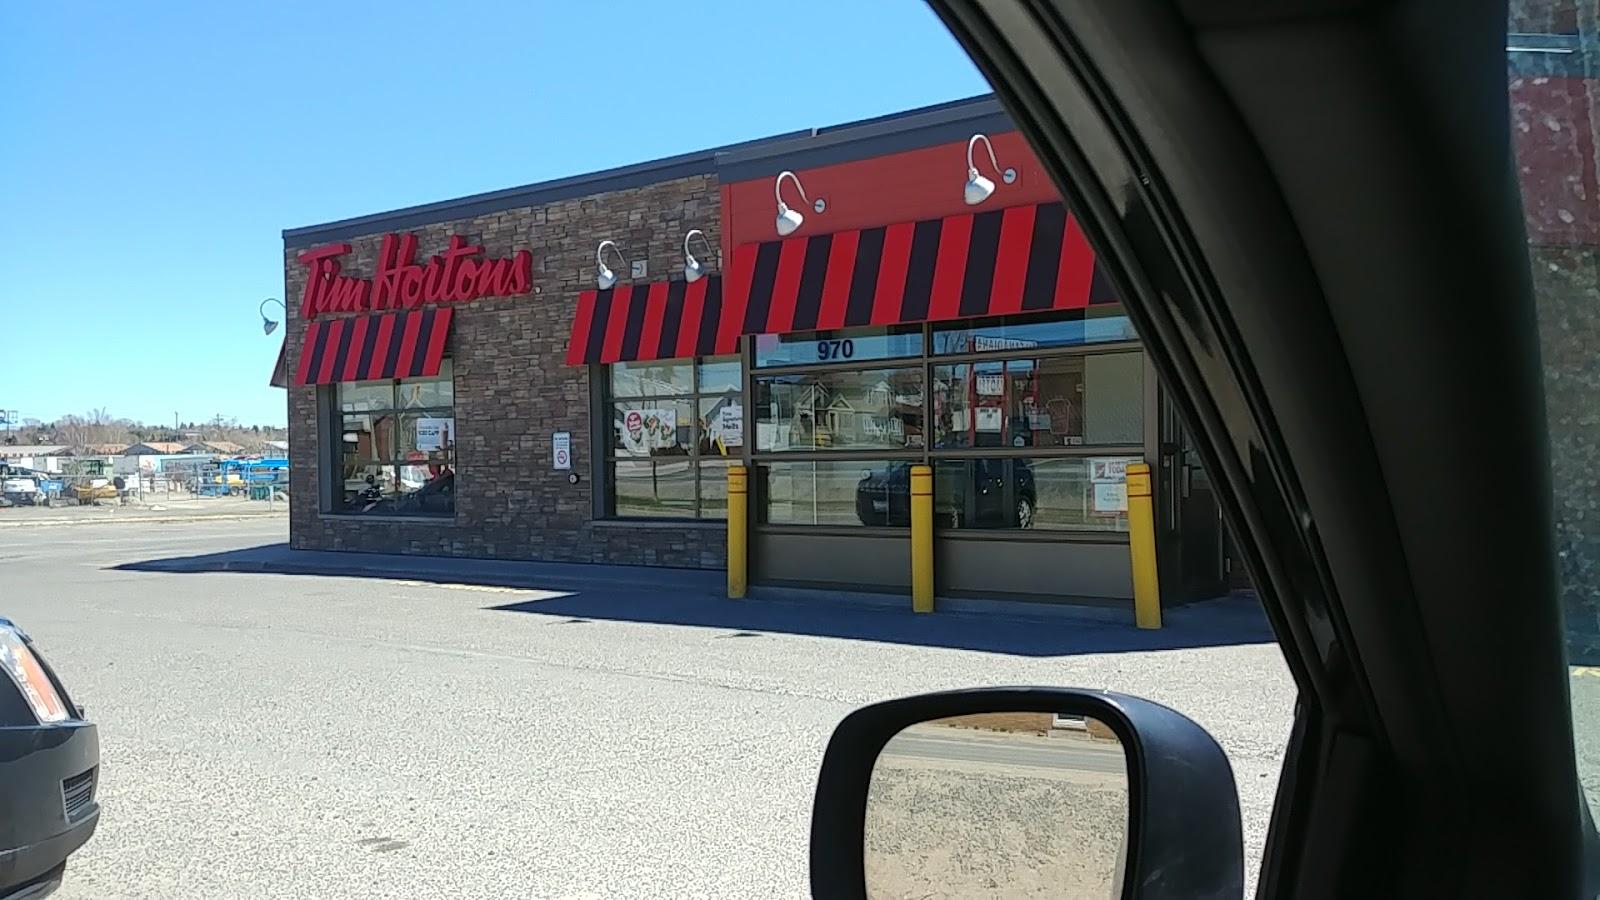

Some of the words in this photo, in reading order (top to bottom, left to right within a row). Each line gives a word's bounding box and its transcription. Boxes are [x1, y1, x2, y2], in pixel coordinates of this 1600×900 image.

[298, 243, 371, 319] Tim
[370, 233, 532, 309] Hortons
[817, 339, 854, 360] 970
